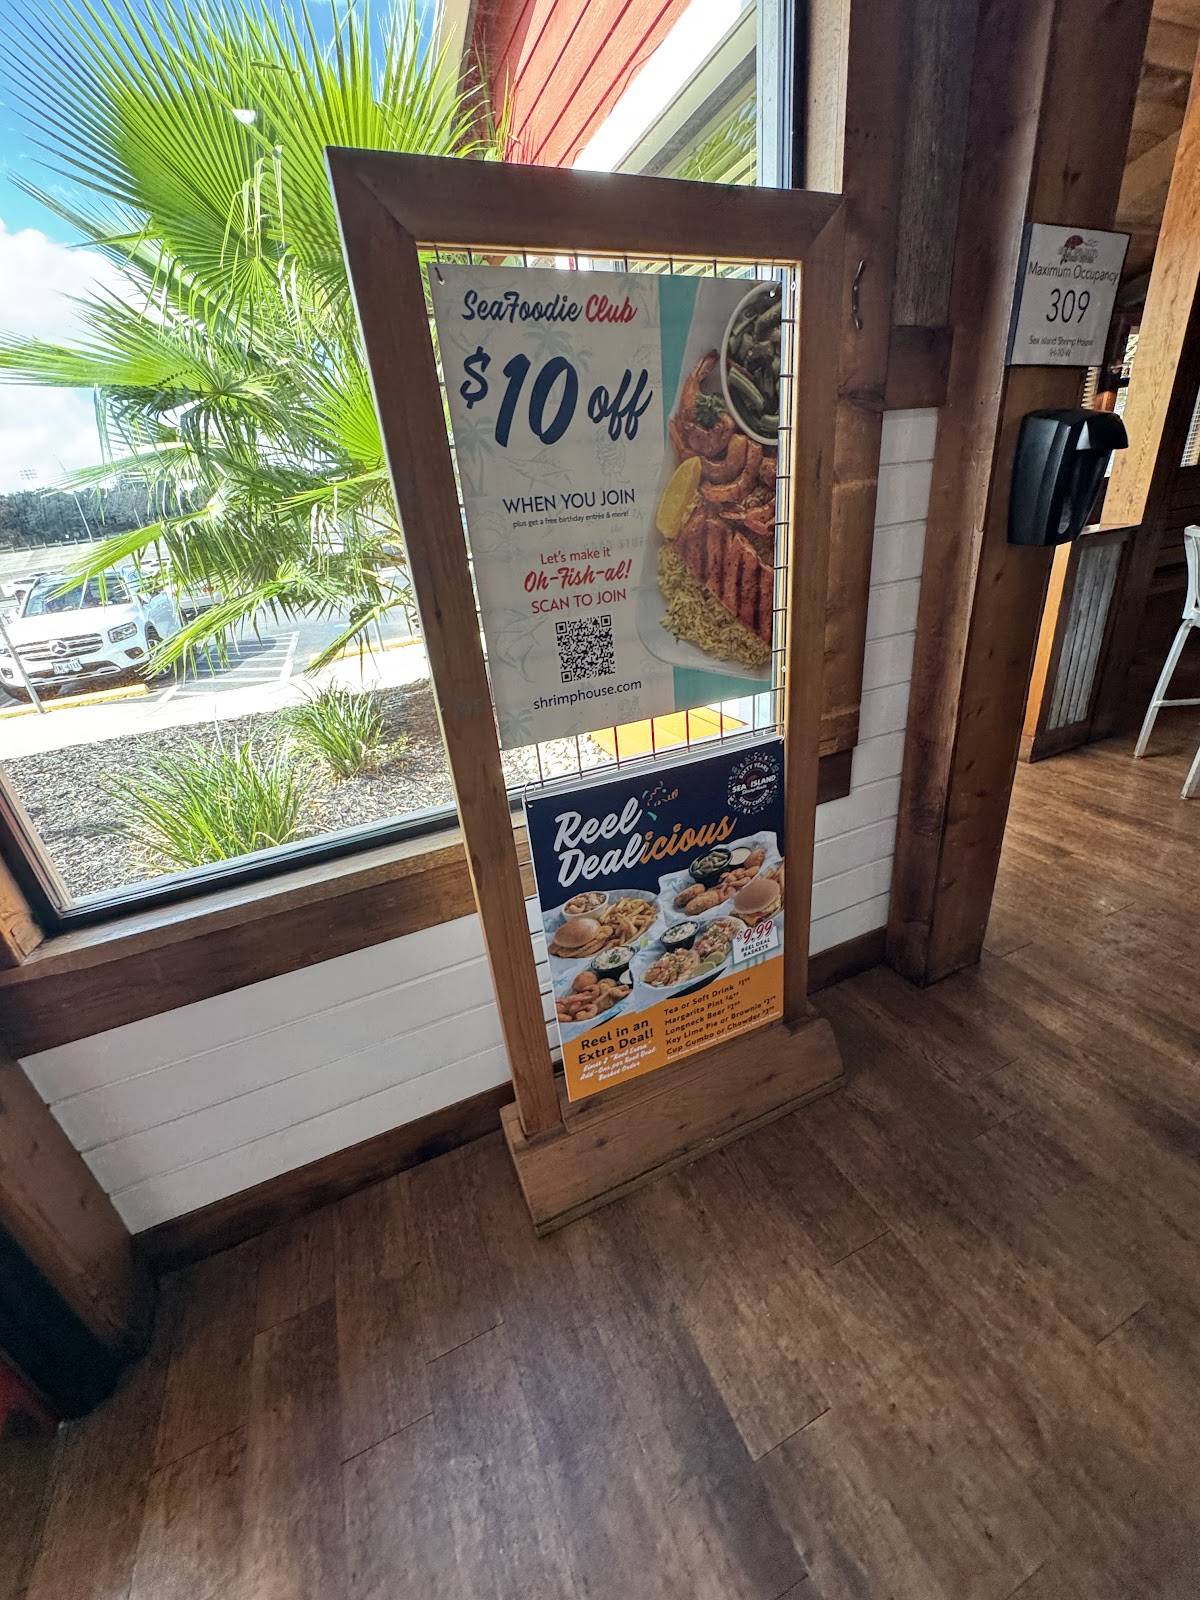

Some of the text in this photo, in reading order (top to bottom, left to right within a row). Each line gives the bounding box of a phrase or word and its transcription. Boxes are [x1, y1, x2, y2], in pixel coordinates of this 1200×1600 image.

[1029, 261, 1119, 285] Maximum Occupancy
[461, 289, 638, 323] SeaFoodie Club
[1046, 288, 1091, 324] 309
[460, 346, 653, 448] $10 off
[502, 488, 635, 514] WHEN YOU JOIN
[528, 519, 540, 528] get
[558, 514, 585, 524] birthday
[611, 510, 630, 518] more!
[540, 546, 611, 565] Let's make it
[523, 559, 633, 593] Oh-Fish-al!
[531, 589, 627, 614] SCAN TO JOIN
[533, 680, 642, 710] shrimphouse.com
[731, 784, 748, 793] SEA
[750, 774, 777, 788] ISLAND
[553, 797, 643, 852] Reel
[557, 815, 738, 888] Dealicious
[664, 1007, 679, 1016] Tea
[681, 1001, 690, 1009] or
[692, 992, 710, 1005] Soft
[711, 985, 734, 997] Drink
[664, 1006, 705, 1026] Margarita
[707, 999, 723, 1009] Pint
[581, 1020, 649, 1050] Reel in an
[665, 1016, 705, 1036] Longneck
[707, 1008, 726, 1019] Beer
[666, 1035, 682, 1045] Key
[684, 1027, 704, 1039] Lime
[705, 1020, 718, 1030] Pie
[720, 1016, 729, 1024] or
[731, 1003, 762, 1019] Brownie
[666, 1045, 683, 1055] Cup
[685, 1033, 715, 1047] Gumbo
[716, 1028, 725, 1036] or
[727, 1013, 761, 1030] Chowder
[578, 1028, 654, 1064] Extra Deal!
